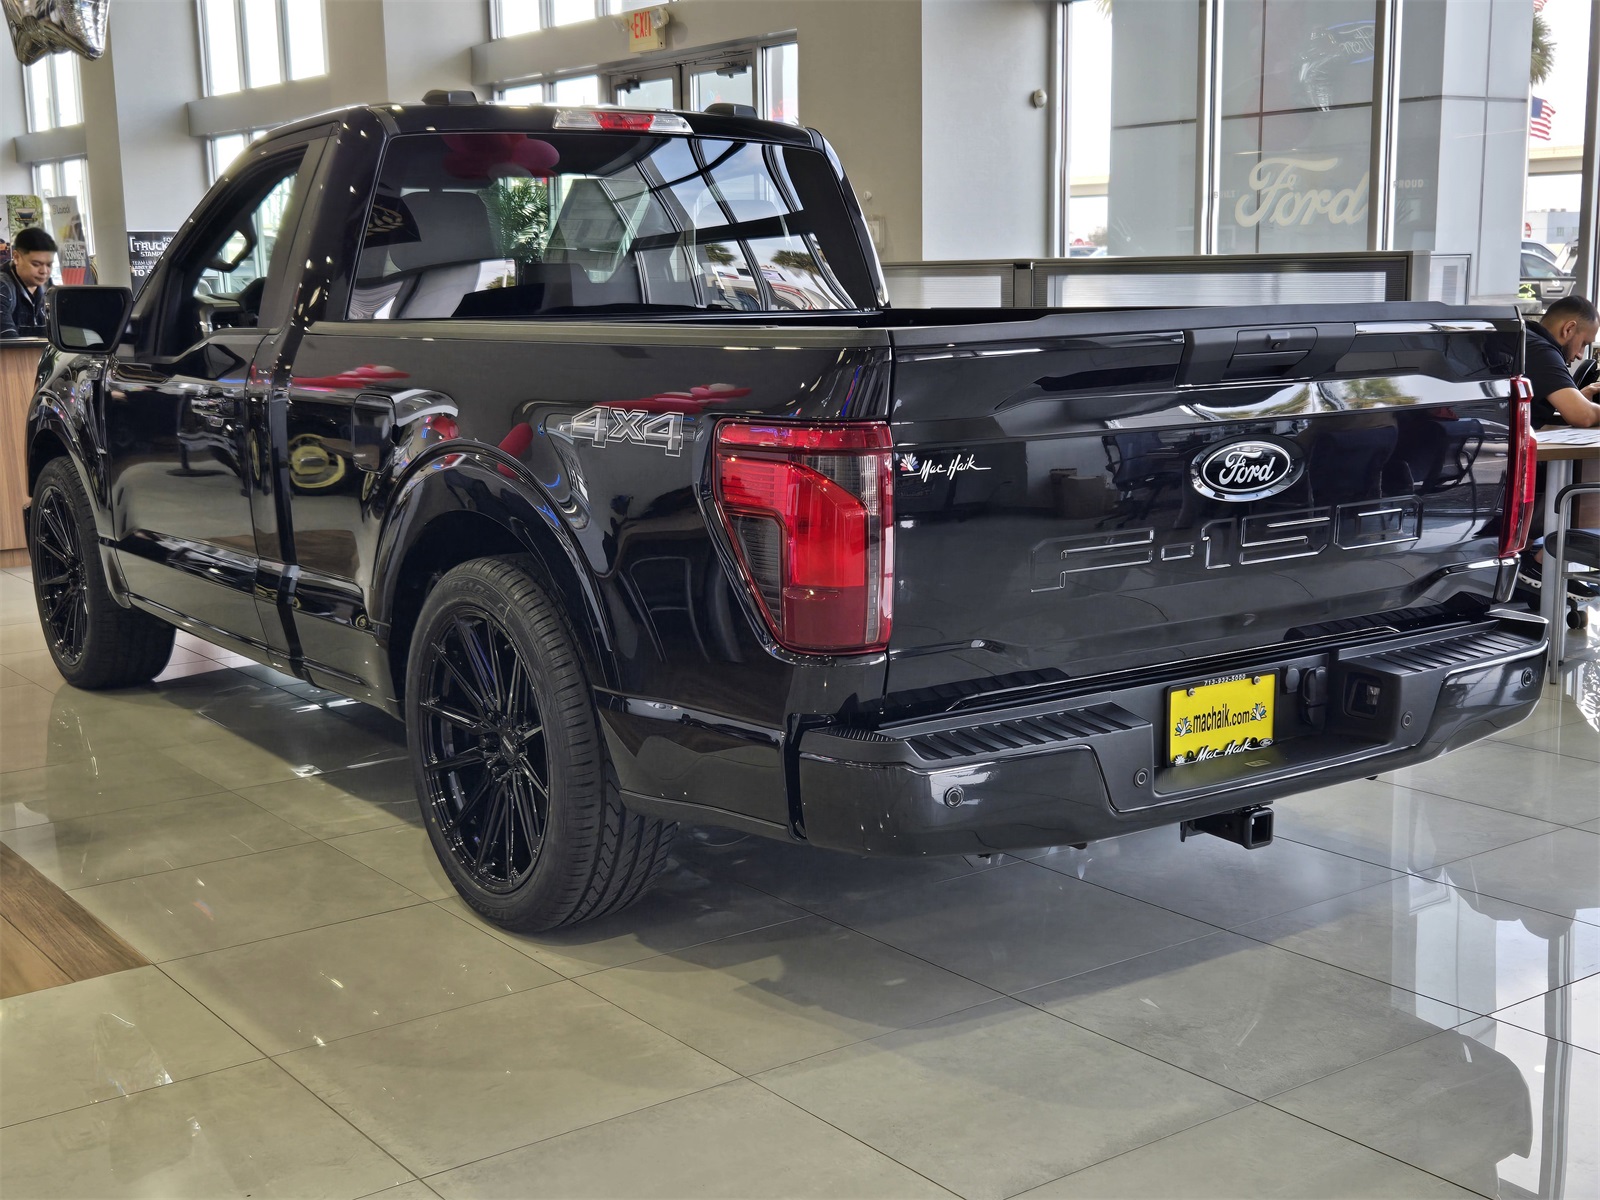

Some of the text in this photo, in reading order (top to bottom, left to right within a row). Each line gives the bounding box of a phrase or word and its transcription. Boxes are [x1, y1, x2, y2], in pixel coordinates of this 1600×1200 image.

[634, 11, 652, 39] EXIT
[1234, 157, 1369, 228] Ford
[917, 453, 986, 482] Mac Haik
[1219, 451, 1276, 485] Ford
[1030, 495, 1423, 593] F-150
[1193, 703, 1250, 733] machaik.com
[1196, 745, 1223, 762] Mac
[1224, 738, 1255, 756] Haik
